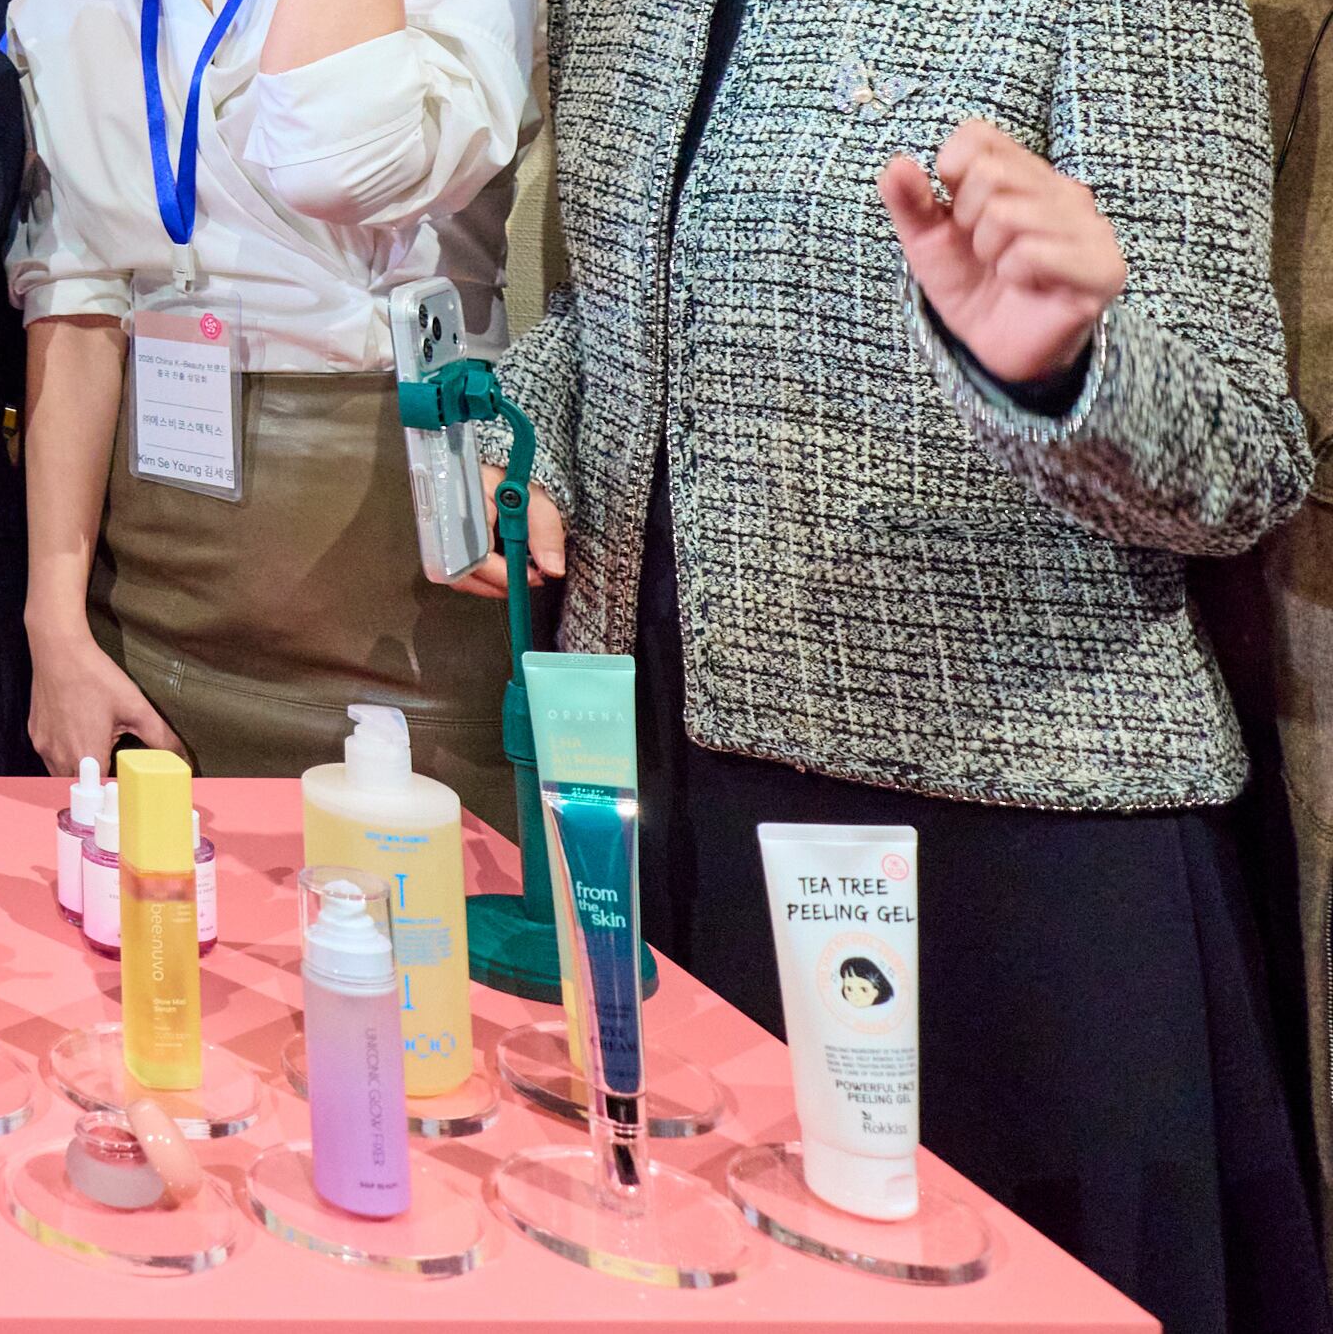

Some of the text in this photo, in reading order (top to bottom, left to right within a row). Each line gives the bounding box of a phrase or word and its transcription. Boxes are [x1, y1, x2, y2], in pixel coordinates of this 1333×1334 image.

[139, 454, 155, 467] Kim
[158, 457, 170, 470] Se
[172, 460, 202, 478] Young
[576, 881, 618, 902] from
[798, 876, 889, 897] TEA TREE
[579, 899, 599, 912] the
[786, 903, 917, 924] PEELING GEL
[591, 910, 626, 928] skin
[836, 1079, 915, 1093] POWERFUL FAC
[848, 1092, 911, 1104] PEELING GEL
